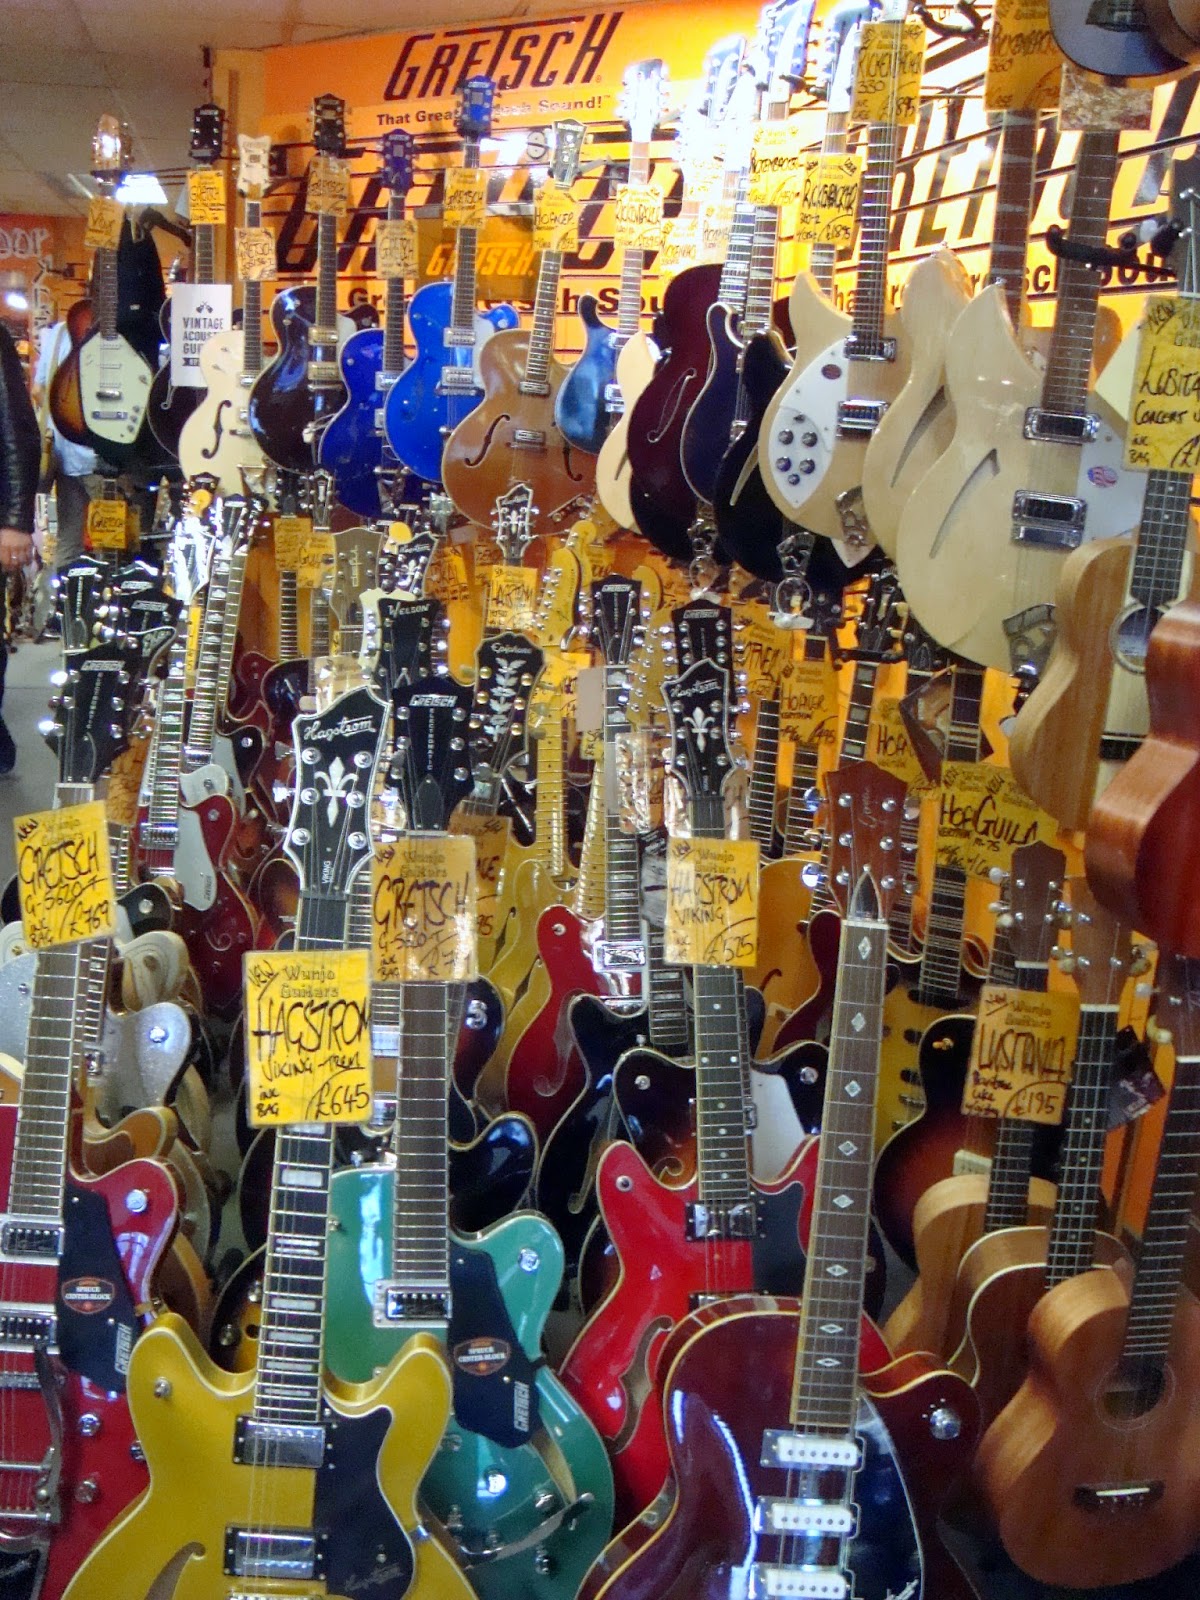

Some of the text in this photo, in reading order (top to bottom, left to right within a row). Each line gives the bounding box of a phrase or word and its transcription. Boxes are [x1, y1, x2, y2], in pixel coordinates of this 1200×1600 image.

[384, 12, 624, 100] GRETSCH
[856, 79, 886, 94] 330
[377, 112, 411, 126] That
[539, 95, 603, 113] Sound!
[182, 317, 224, 330] VINTAGE
[408, 693, 459, 708] GRETSCH
[303, 714, 377, 743] Hagstrom
[19, 831, 100, 896] GRETSCH
[315, 1081, 371, 1121] £645
